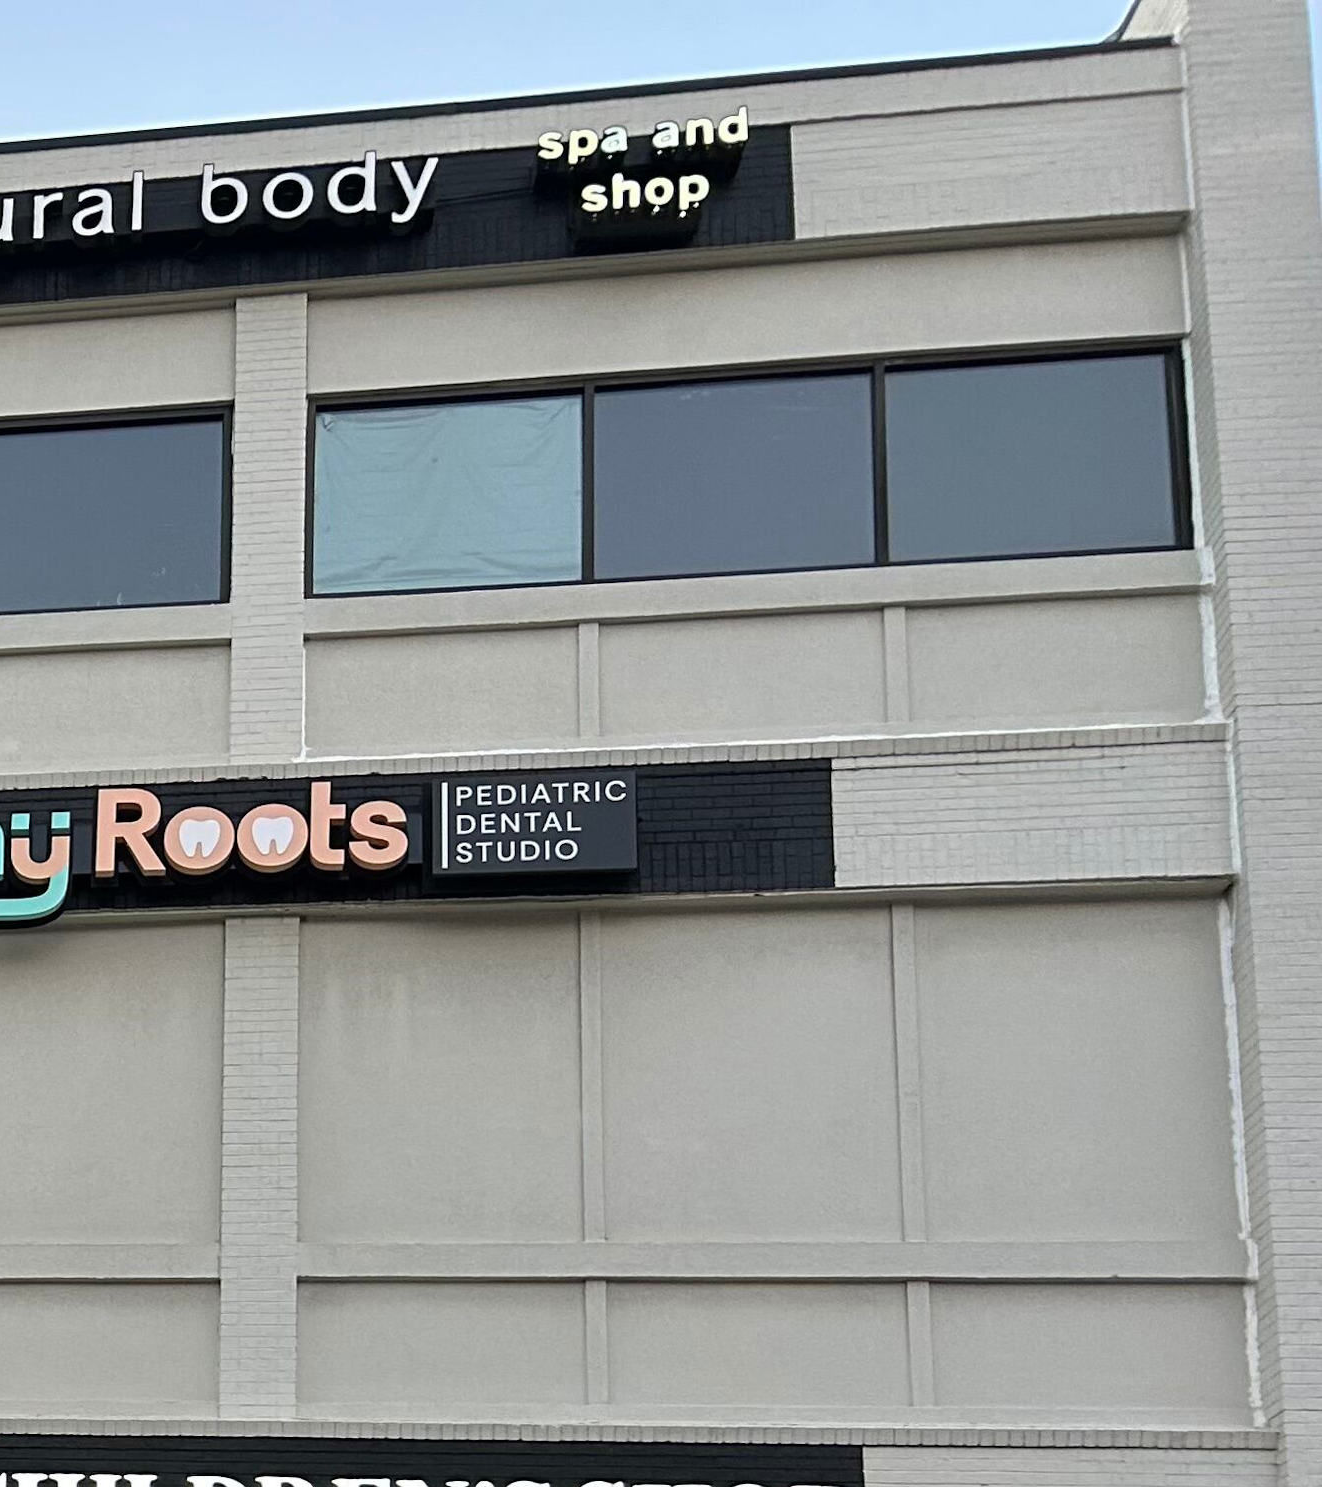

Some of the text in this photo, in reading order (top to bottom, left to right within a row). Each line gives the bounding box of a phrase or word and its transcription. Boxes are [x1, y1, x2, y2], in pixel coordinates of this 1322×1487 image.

[538, 105, 748, 164] spa and
[202, 151, 439, 224] body
[581, 173, 709, 210] shop
[456, 780, 627, 807] PEDIATRIC
[95, 781, 409, 876] Roots
[456, 810, 582, 836] DENTAL
[455, 839, 578, 863] STUDIO
